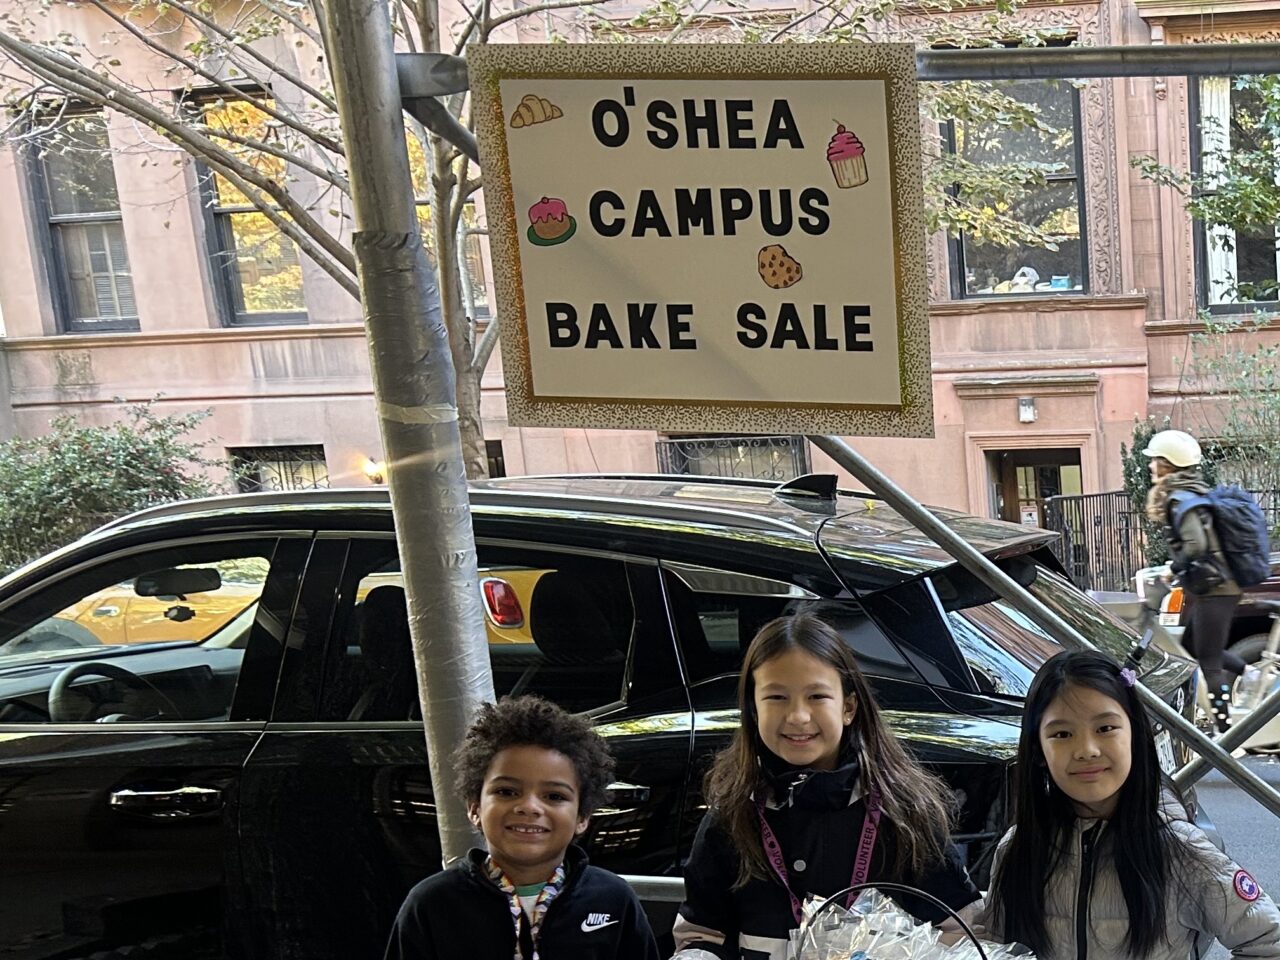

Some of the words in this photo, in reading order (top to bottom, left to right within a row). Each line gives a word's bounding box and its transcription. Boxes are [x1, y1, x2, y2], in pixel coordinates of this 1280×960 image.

[591, 87, 804, 149] O'SHEA
[589, 188, 830, 236] CAMPUS
[546, 303, 697, 350] BAKE
[737, 303, 873, 351] SALE
[854, 826, 875, 885] VOLUNTEER
[587, 913, 610, 924] NIKE
